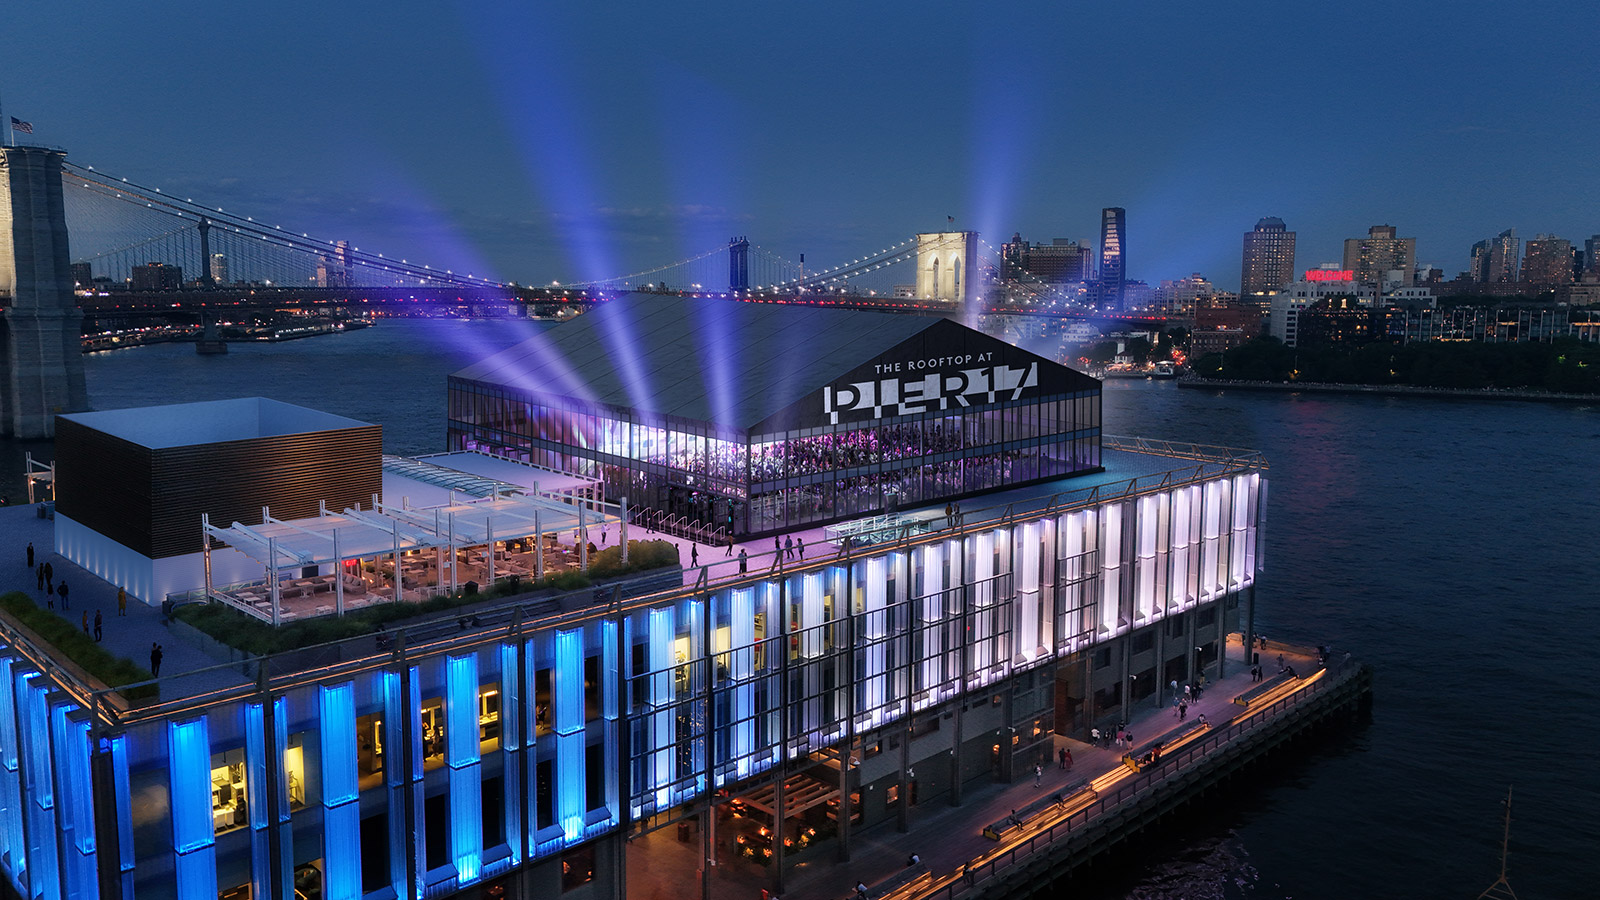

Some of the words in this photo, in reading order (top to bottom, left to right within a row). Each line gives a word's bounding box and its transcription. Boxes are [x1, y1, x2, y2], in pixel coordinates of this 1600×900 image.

[1305, 270, 1354, 281] WELCOME
[874, 362, 901, 374] THE
[908, 354, 972, 371] ROOFTOP
[977, 352, 993, 363] AT
